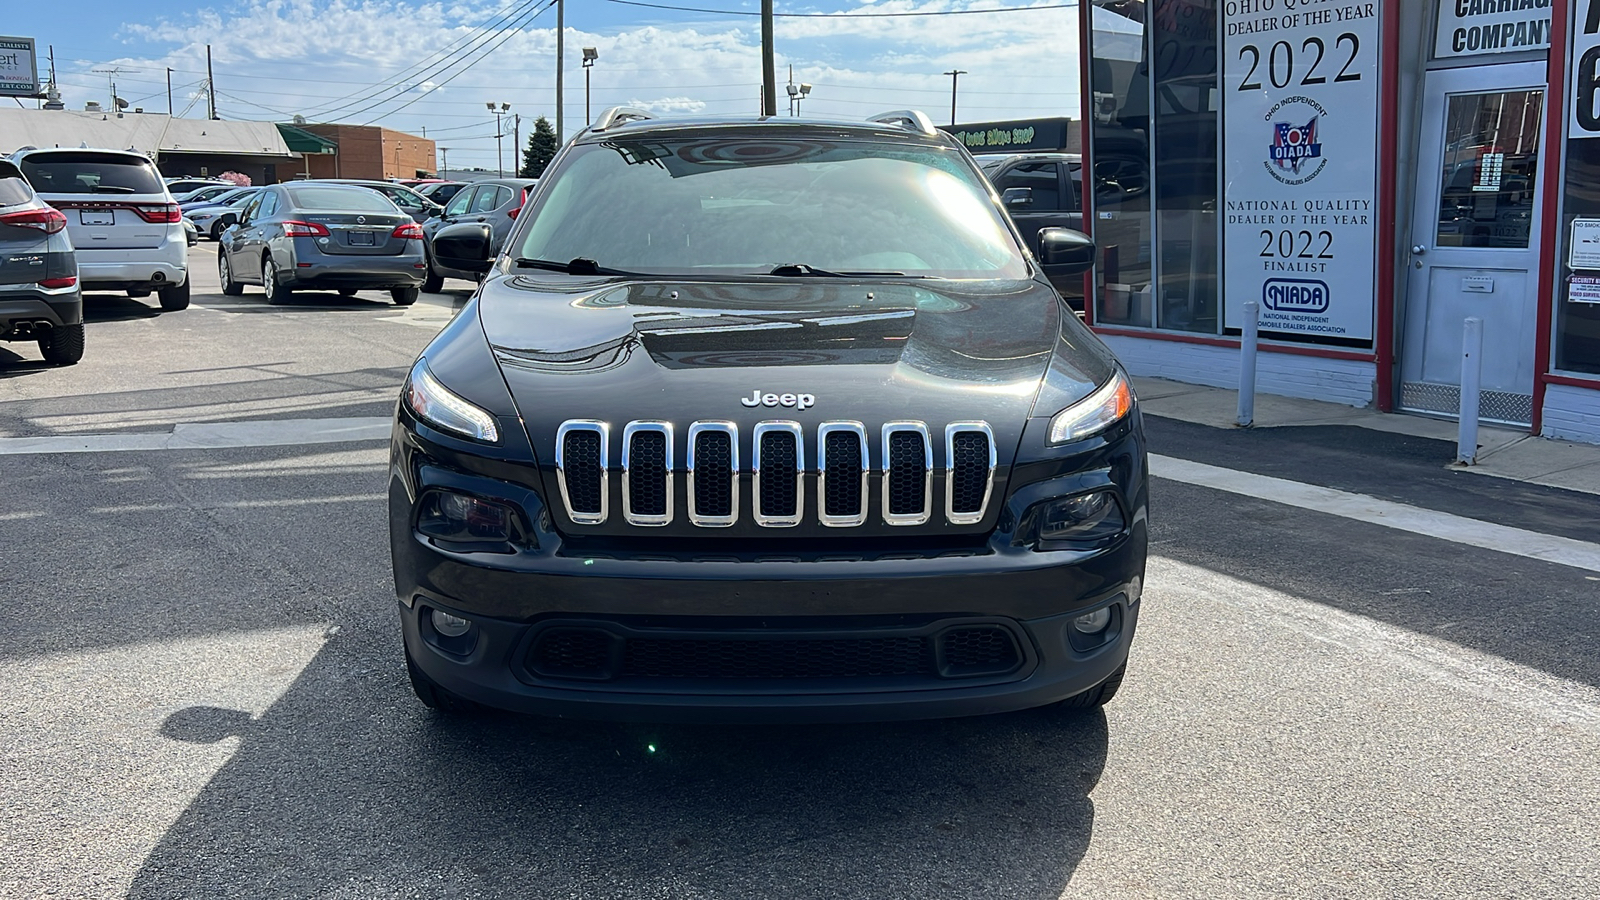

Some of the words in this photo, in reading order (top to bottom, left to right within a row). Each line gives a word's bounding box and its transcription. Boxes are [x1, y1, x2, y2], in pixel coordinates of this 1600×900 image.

[1226, 0, 1274, 16] OHIO
[1228, 17, 1278, 36] DEALER
[1282, 14, 1299, 29] OF
[1303, 9, 1331, 26] THE
[1335, 3, 1375, 21] YEAR
[1452, 19, 1552, 52] COMPANY
[1238, 32, 1361, 91] 2022
[1264, 103, 1280, 121] OHIO
[1281, 96, 1328, 117] INDEPENDENT
[1012, 126, 1034, 145] SHOP
[1275, 145, 1312, 158] OIADA
[1263, 161, 1285, 184] AUTOMOBILE
[1304, 158, 1328, 183] ASSOCIATION
[1227, 200, 1298, 211] NATIONAL
[1304, 200, 1371, 212] QUALITY
[1228, 215, 1275, 224] DEALER
[1280, 215, 1296, 224] OF
[1302, 215, 1327, 225] THE
[1333, 215, 1368, 225] YEAR
[1259, 230, 1334, 259] 2022
[1264, 261, 1327, 273] FINALIST
[1268, 285, 1323, 306] NIADA
[1291, 315, 1329, 323] INDEPENDENT
[1307, 325, 1346, 333] ASSOCIATION
[741, 389, 815, 411] Jeep
